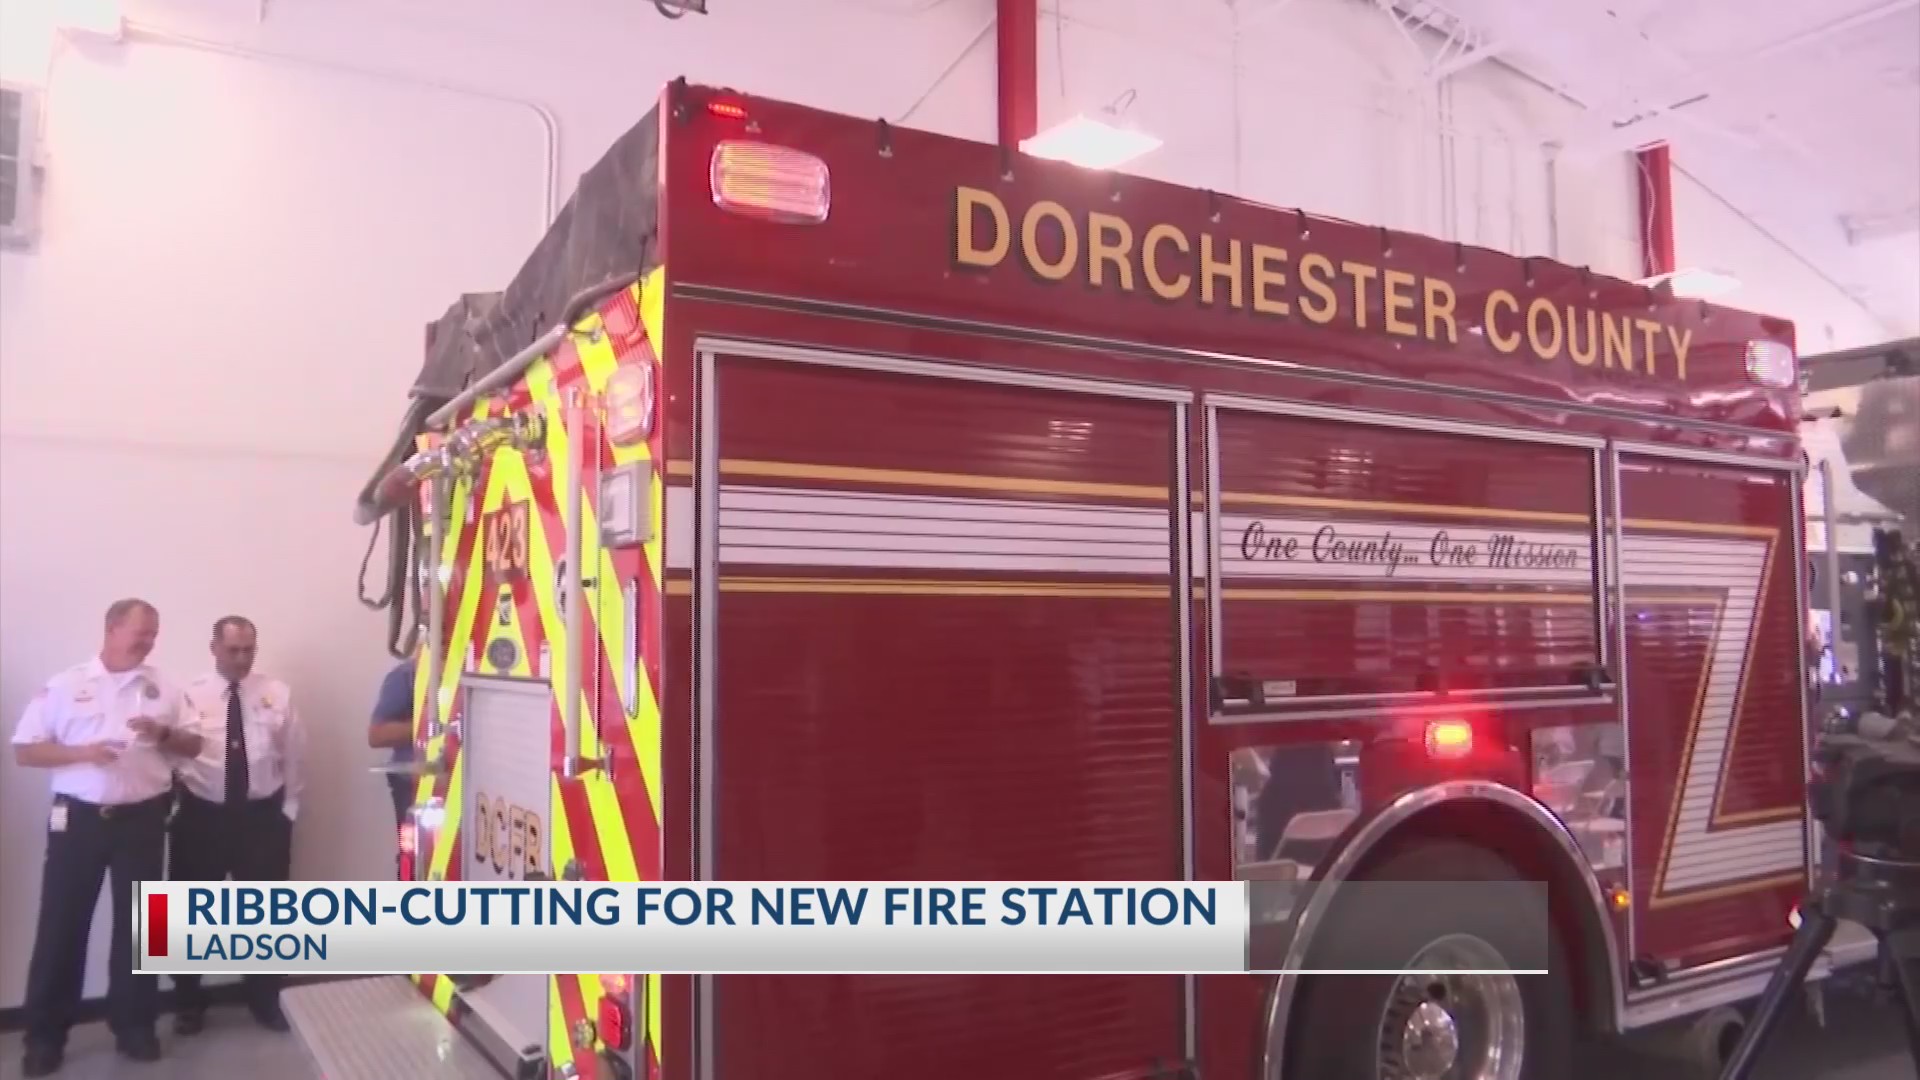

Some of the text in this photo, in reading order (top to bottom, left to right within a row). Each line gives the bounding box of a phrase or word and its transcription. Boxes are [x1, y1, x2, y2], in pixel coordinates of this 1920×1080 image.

[955, 186, 1692, 380] DORCHESTER COUNTY
[487, 509, 526, 572] 423
[1240, 520, 1298, 561] One
[1430, 530, 1478, 567] One
[1487, 533, 1578, 569] Mission
